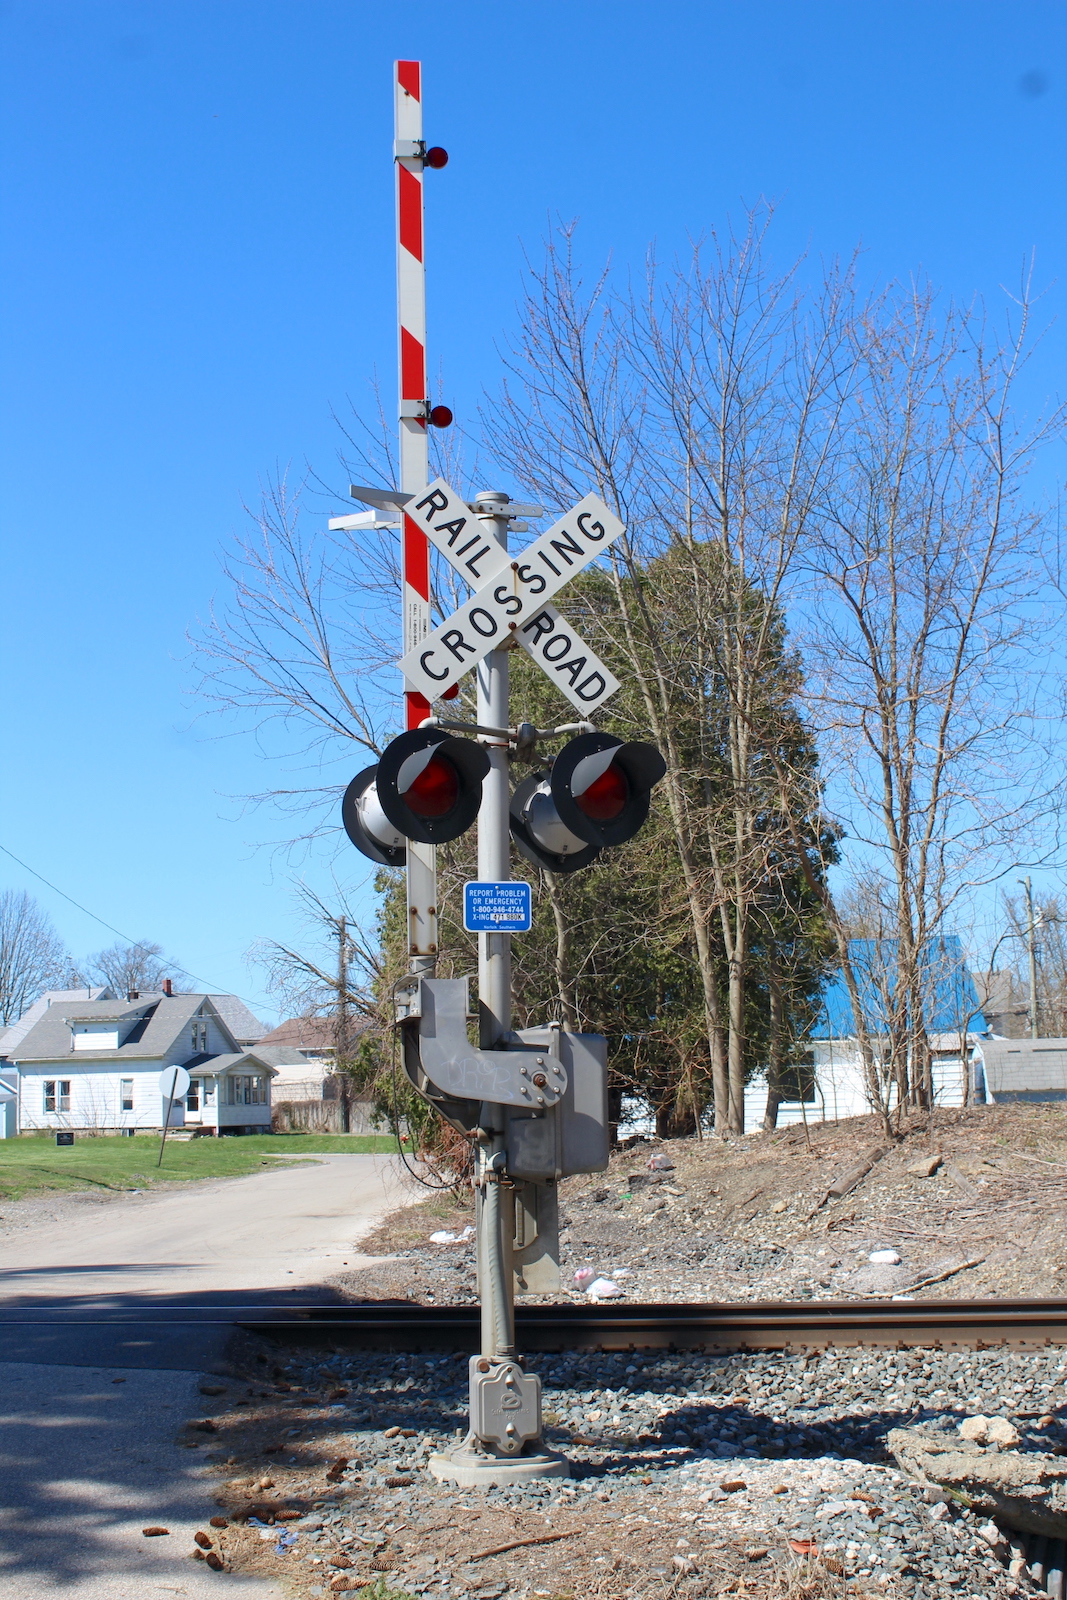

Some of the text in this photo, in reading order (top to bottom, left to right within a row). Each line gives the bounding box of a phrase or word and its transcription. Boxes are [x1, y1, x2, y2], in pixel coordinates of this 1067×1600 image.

[415, 488, 491, 579] RAIL
[420, 512, 606, 681] CROSSING
[522, 610, 606, 702] ROAD
